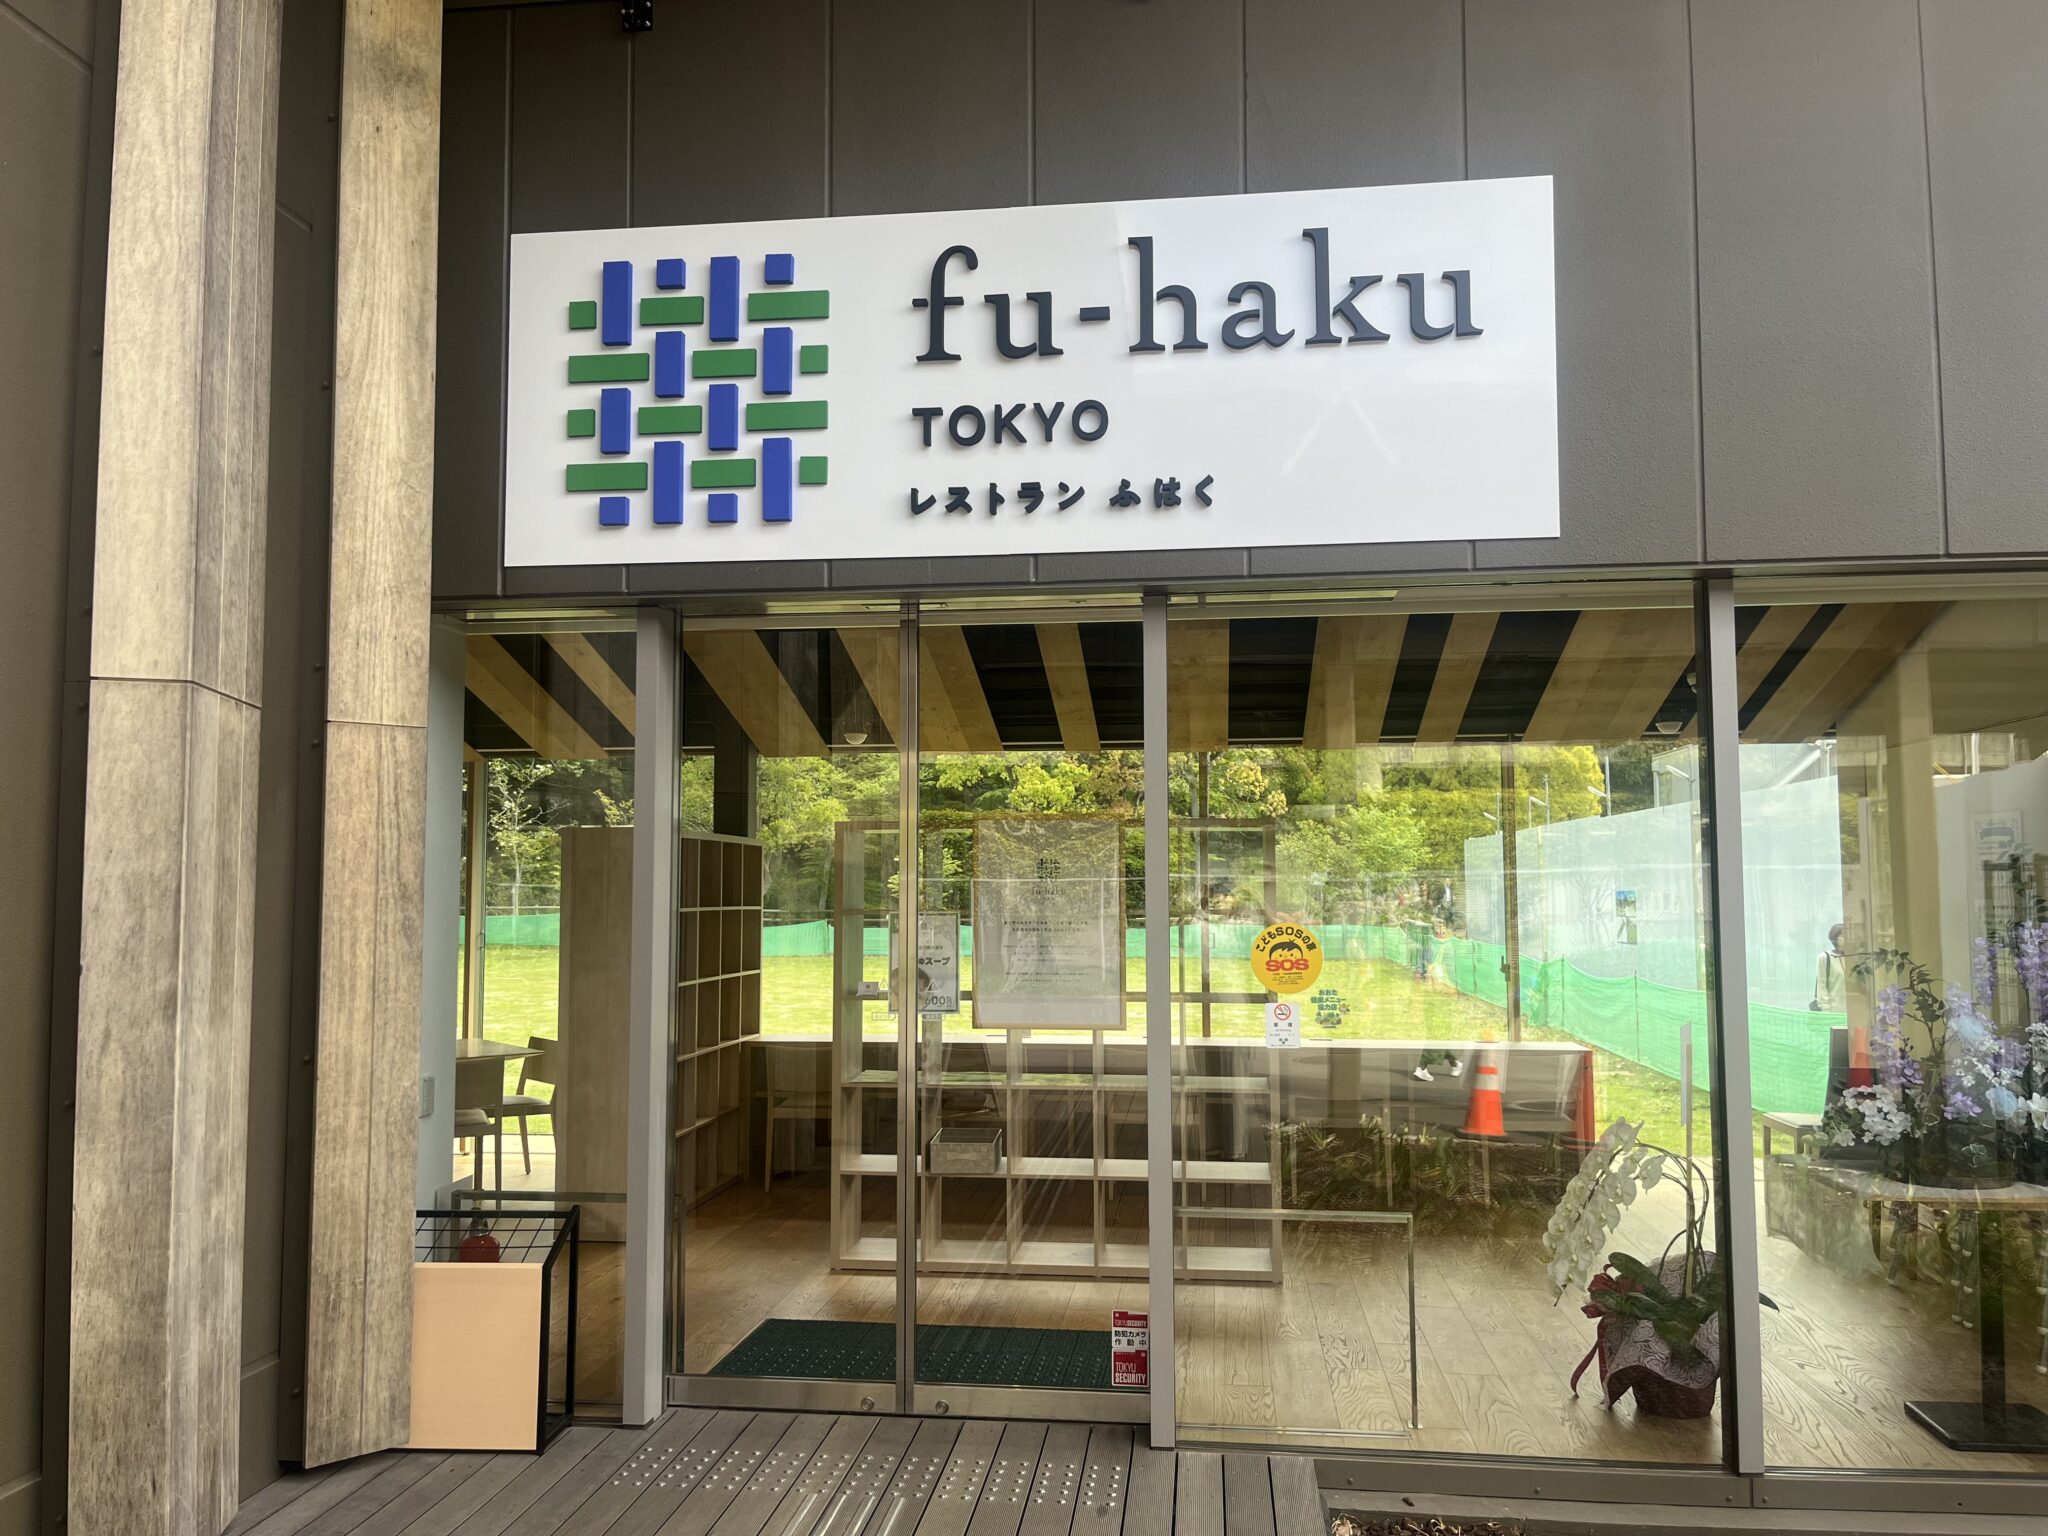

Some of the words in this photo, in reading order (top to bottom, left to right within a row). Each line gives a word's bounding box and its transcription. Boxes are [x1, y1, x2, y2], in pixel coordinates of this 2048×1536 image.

[912, 227, 1484, 362] fu-haku
[912, 399, 1109, 447] TOKYO
[910, 482, 1085, 515] レストラン
[1108, 474, 1214, 508] ふはく
[1265, 959, 1310, 972] SOS
[1114, 1330, 1147, 1338] 防犯カメラ
[1115, 1362, 1137, 1373] TOKYU
[1115, 1373, 1146, 1384] SECURITY
